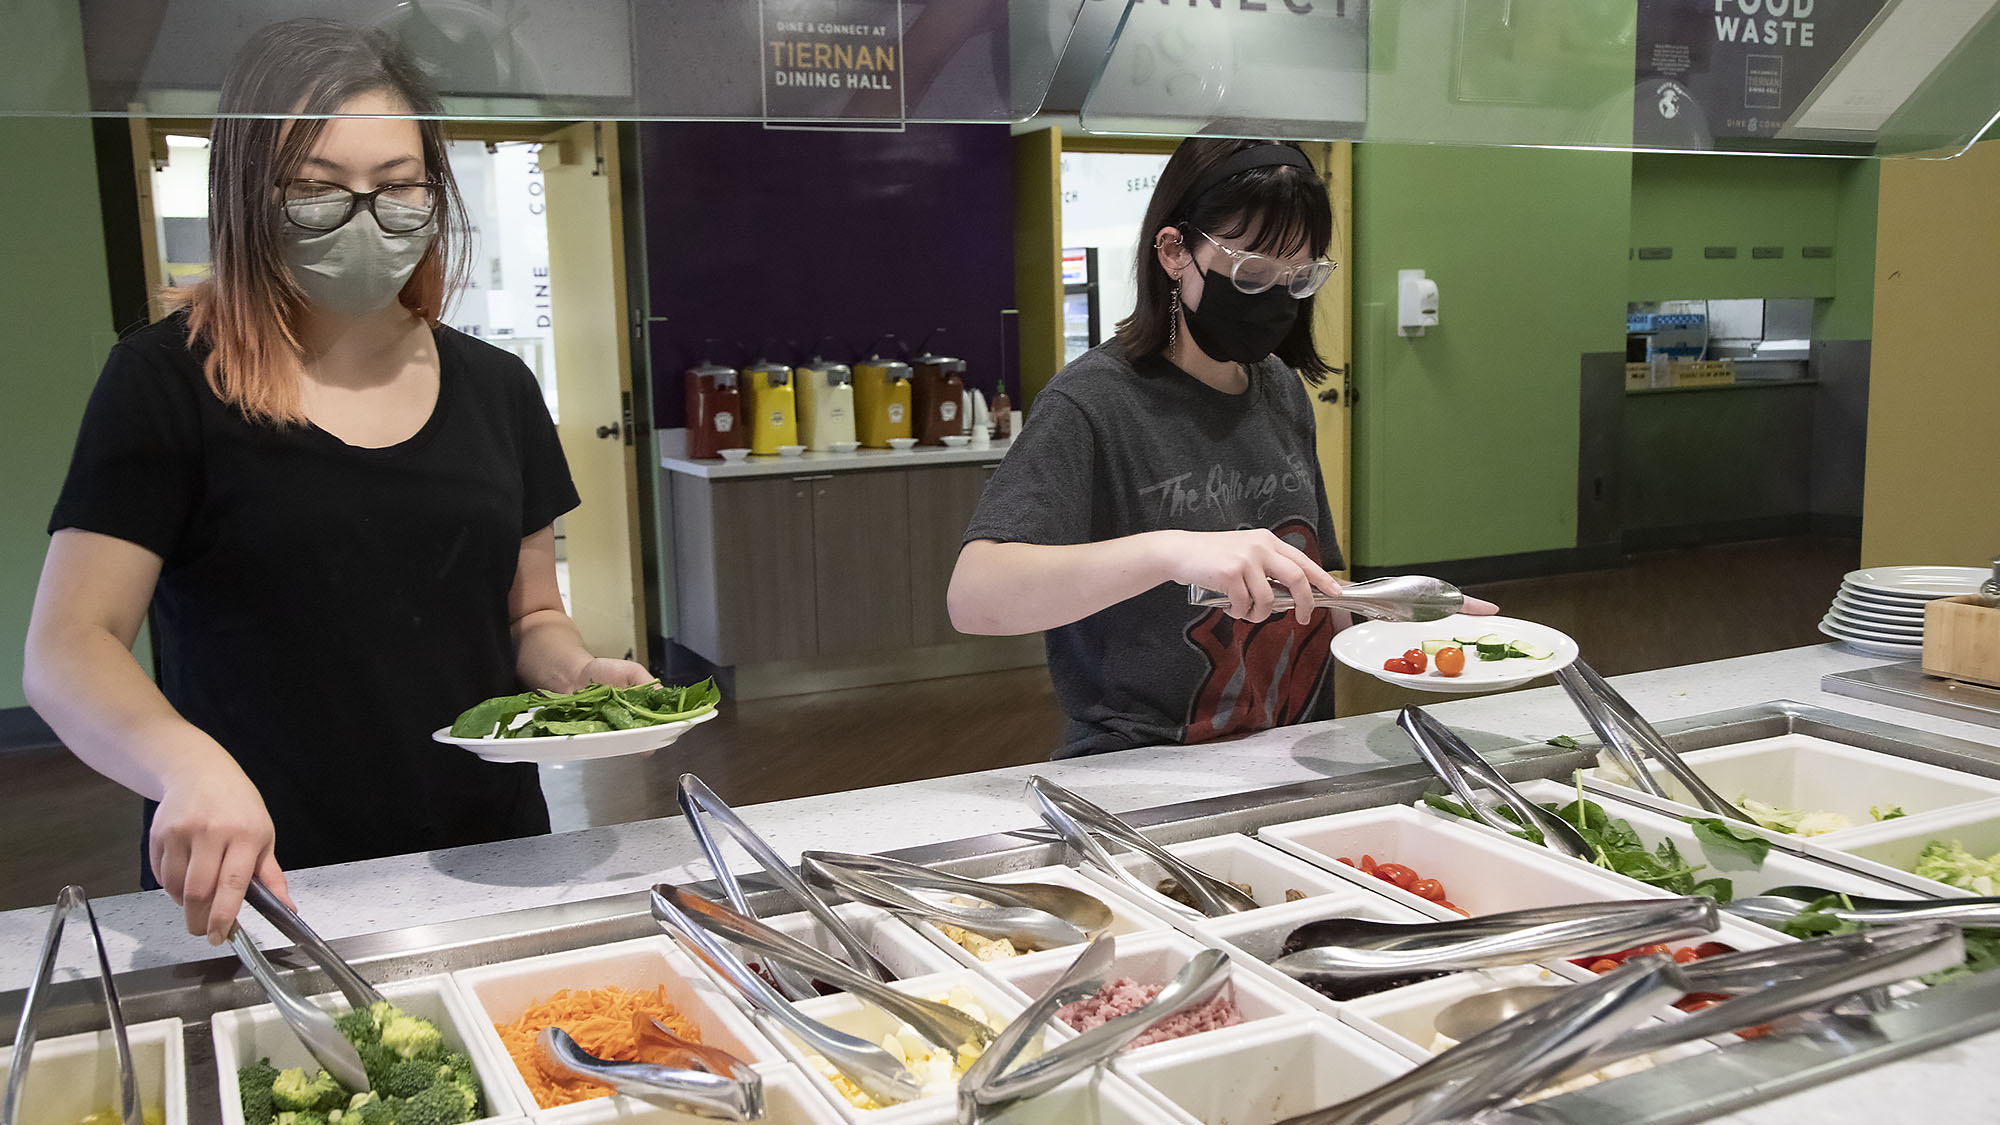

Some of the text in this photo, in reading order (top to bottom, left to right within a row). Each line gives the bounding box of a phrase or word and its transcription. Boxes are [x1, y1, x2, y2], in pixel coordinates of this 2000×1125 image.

[777, 22, 887, 37] DINE & CONNECT AT
[1714, 16, 1814, 47] WASTE
[769, 41, 895, 71] TIERNAN
[775, 71, 892, 90] DINING HALL
[533, 266, 551, 329] DINE
[1137, 471, 1200, 524] The
